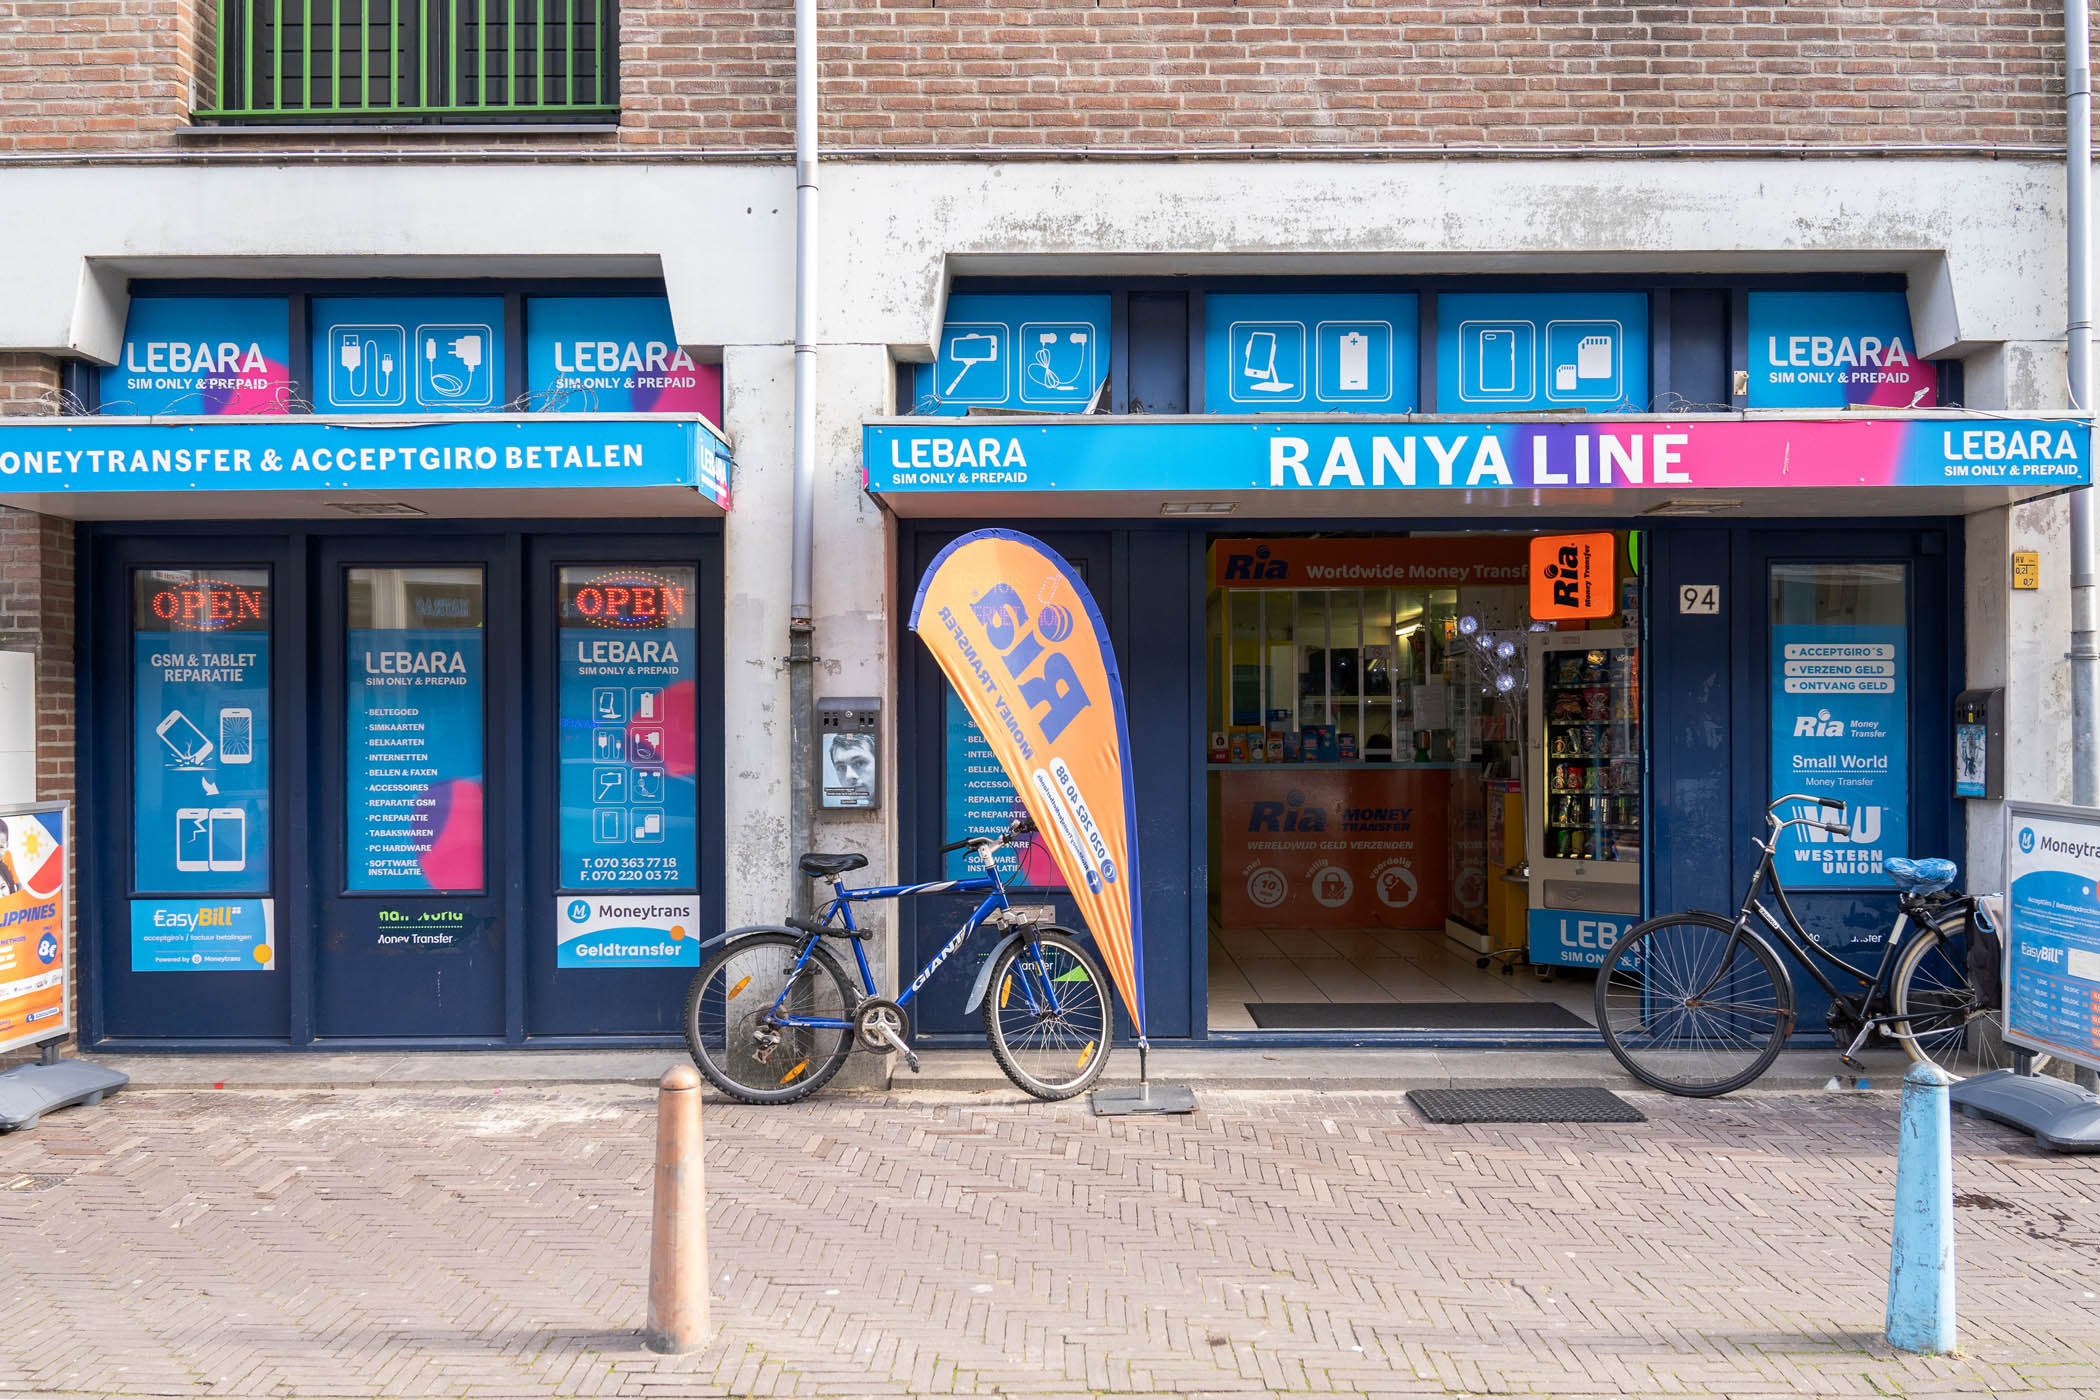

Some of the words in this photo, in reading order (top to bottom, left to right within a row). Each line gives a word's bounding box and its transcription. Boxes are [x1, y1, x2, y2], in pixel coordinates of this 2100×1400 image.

[128, 342, 268, 373] LEBARA
[554, 341, 696, 372] LEBARA
[1768, 336, 1909, 367] LEBARA
[127, 378, 152, 390] SIM
[155, 378, 191, 390] ONLY
[195, 378, 207, 390] &
[209, 378, 268, 390] PREPAID
[556, 377, 581, 389] SIM
[584, 377, 620, 389] ONLY
[623, 377, 635, 389] &
[638, 377, 696, 389] PREPAID
[1769, 372, 1794, 384] SIM
[1797, 372, 1834, 384] ONLY
[1837, 372, 1849, 384] &
[1852, 372, 1909, 384] PREPAID
[1943, 430, 2078, 460] LEBARA
[260, 449, 283, 472] &
[290, 446, 497, 471] ACCEPTGIRO
[506, 444, 643, 469] BETALEN
[891, 438, 1027, 468] LEBARA
[1270, 435, 1514, 486] RANYA
[1532, 433, 1690, 485] LINE
[1944, 465, 1969, 477] SIM
[1971, 465, 2007, 477] ONLY
[2009, 465, 2020, 477] &
[2022, 465, 2078, 477] PREPAID
[892, 473, 917, 485] SIM
[919, 473, 955, 484] ONLY
[957, 473, 969, 484] &
[971, 472, 1028, 484] PREPAID
[1224, 544, 1288, 580] Ria
[1306, 564, 1404, 579] Worldwide
[1409, 564, 1469, 581] Money
[1584, 545, 1592, 578] Transfer
[1544, 545, 1579, 608] Ria
[1584, 581, 1592, 607] Money
[1684, 588, 1716, 610] 94
[153, 591, 262, 619] OPEN
[576, 587, 685, 616] OPEN
[578, 641, 679, 663] LEBARA
[151, 654, 184, 667] GSM
[187, 654, 199, 667] &
[202, 653, 256, 667] TABLET
[366, 651, 467, 674] LEBARA
[164, 669, 243, 682] REPARATIE
[578, 667, 597, 675] SIM
[599, 667, 625, 675] ONLY
[627, 667, 636, 675] &
[637, 666, 679, 675] PREPAID
[1800, 665, 1852, 674] VERZEND
[1855, 665, 1884, 674] GELD
[366, 677, 384, 686] SIM
[386, 677, 412, 686] ONLY
[415, 677, 423, 686] &
[425, 677, 467, 685] PREPAID
[1800, 681, 1855, 690] ONTVANG
[1858, 681, 1888, 690] GELD
[1793, 708, 1845, 737] Ria
[1850, 720, 1879, 729] Money
[1851, 730, 1887, 738] Transfer
[1792, 755, 1836, 768] Small
[1840, 755, 1888, 768] World
[1805, 777, 1835, 788] Money
[1838, 777, 1874, 786] Transfer
[1248, 789, 1327, 833] Ria
[1343, 808, 1413, 821] MONEY
[369, 814, 381, 822] PC
[382, 814, 428, 822] REPARATIE
[1342, 823, 1411, 833] TRANSFER
[369, 844, 381, 852] PC
[382, 844, 432, 852] HARDWARE
[1248, 841, 1317, 850] WERELDWIJD
[1320, 841, 1347, 850] GELD
[1350, 841, 1414, 849] VERZENDEN
[582, 858, 593, 868] T.
[594, 858, 619, 868] 070
[621, 858, 644, 868] 363
[646, 858, 661, 868] 77
[662, 857, 677, 867] 18
[1794, 850, 1883, 862] WESTERN
[1822, 862, 1883, 874] UNION
[580, 871, 590, 881] F.
[591, 871, 616, 881] 070
[618, 871, 642, 880] 220
[645, 871, 662, 880] 03
[664, 870, 679, 880] 72
[0, 903, 56, 927] IPPINES
[599, 905, 690, 920] Moneytrans
[411, 933, 453, 944] Transfer
[576, 942, 681, 957] Geldtransfer
[912, 923, 968, 992] GIANT
[1561, 951, 1583, 963] SIM
